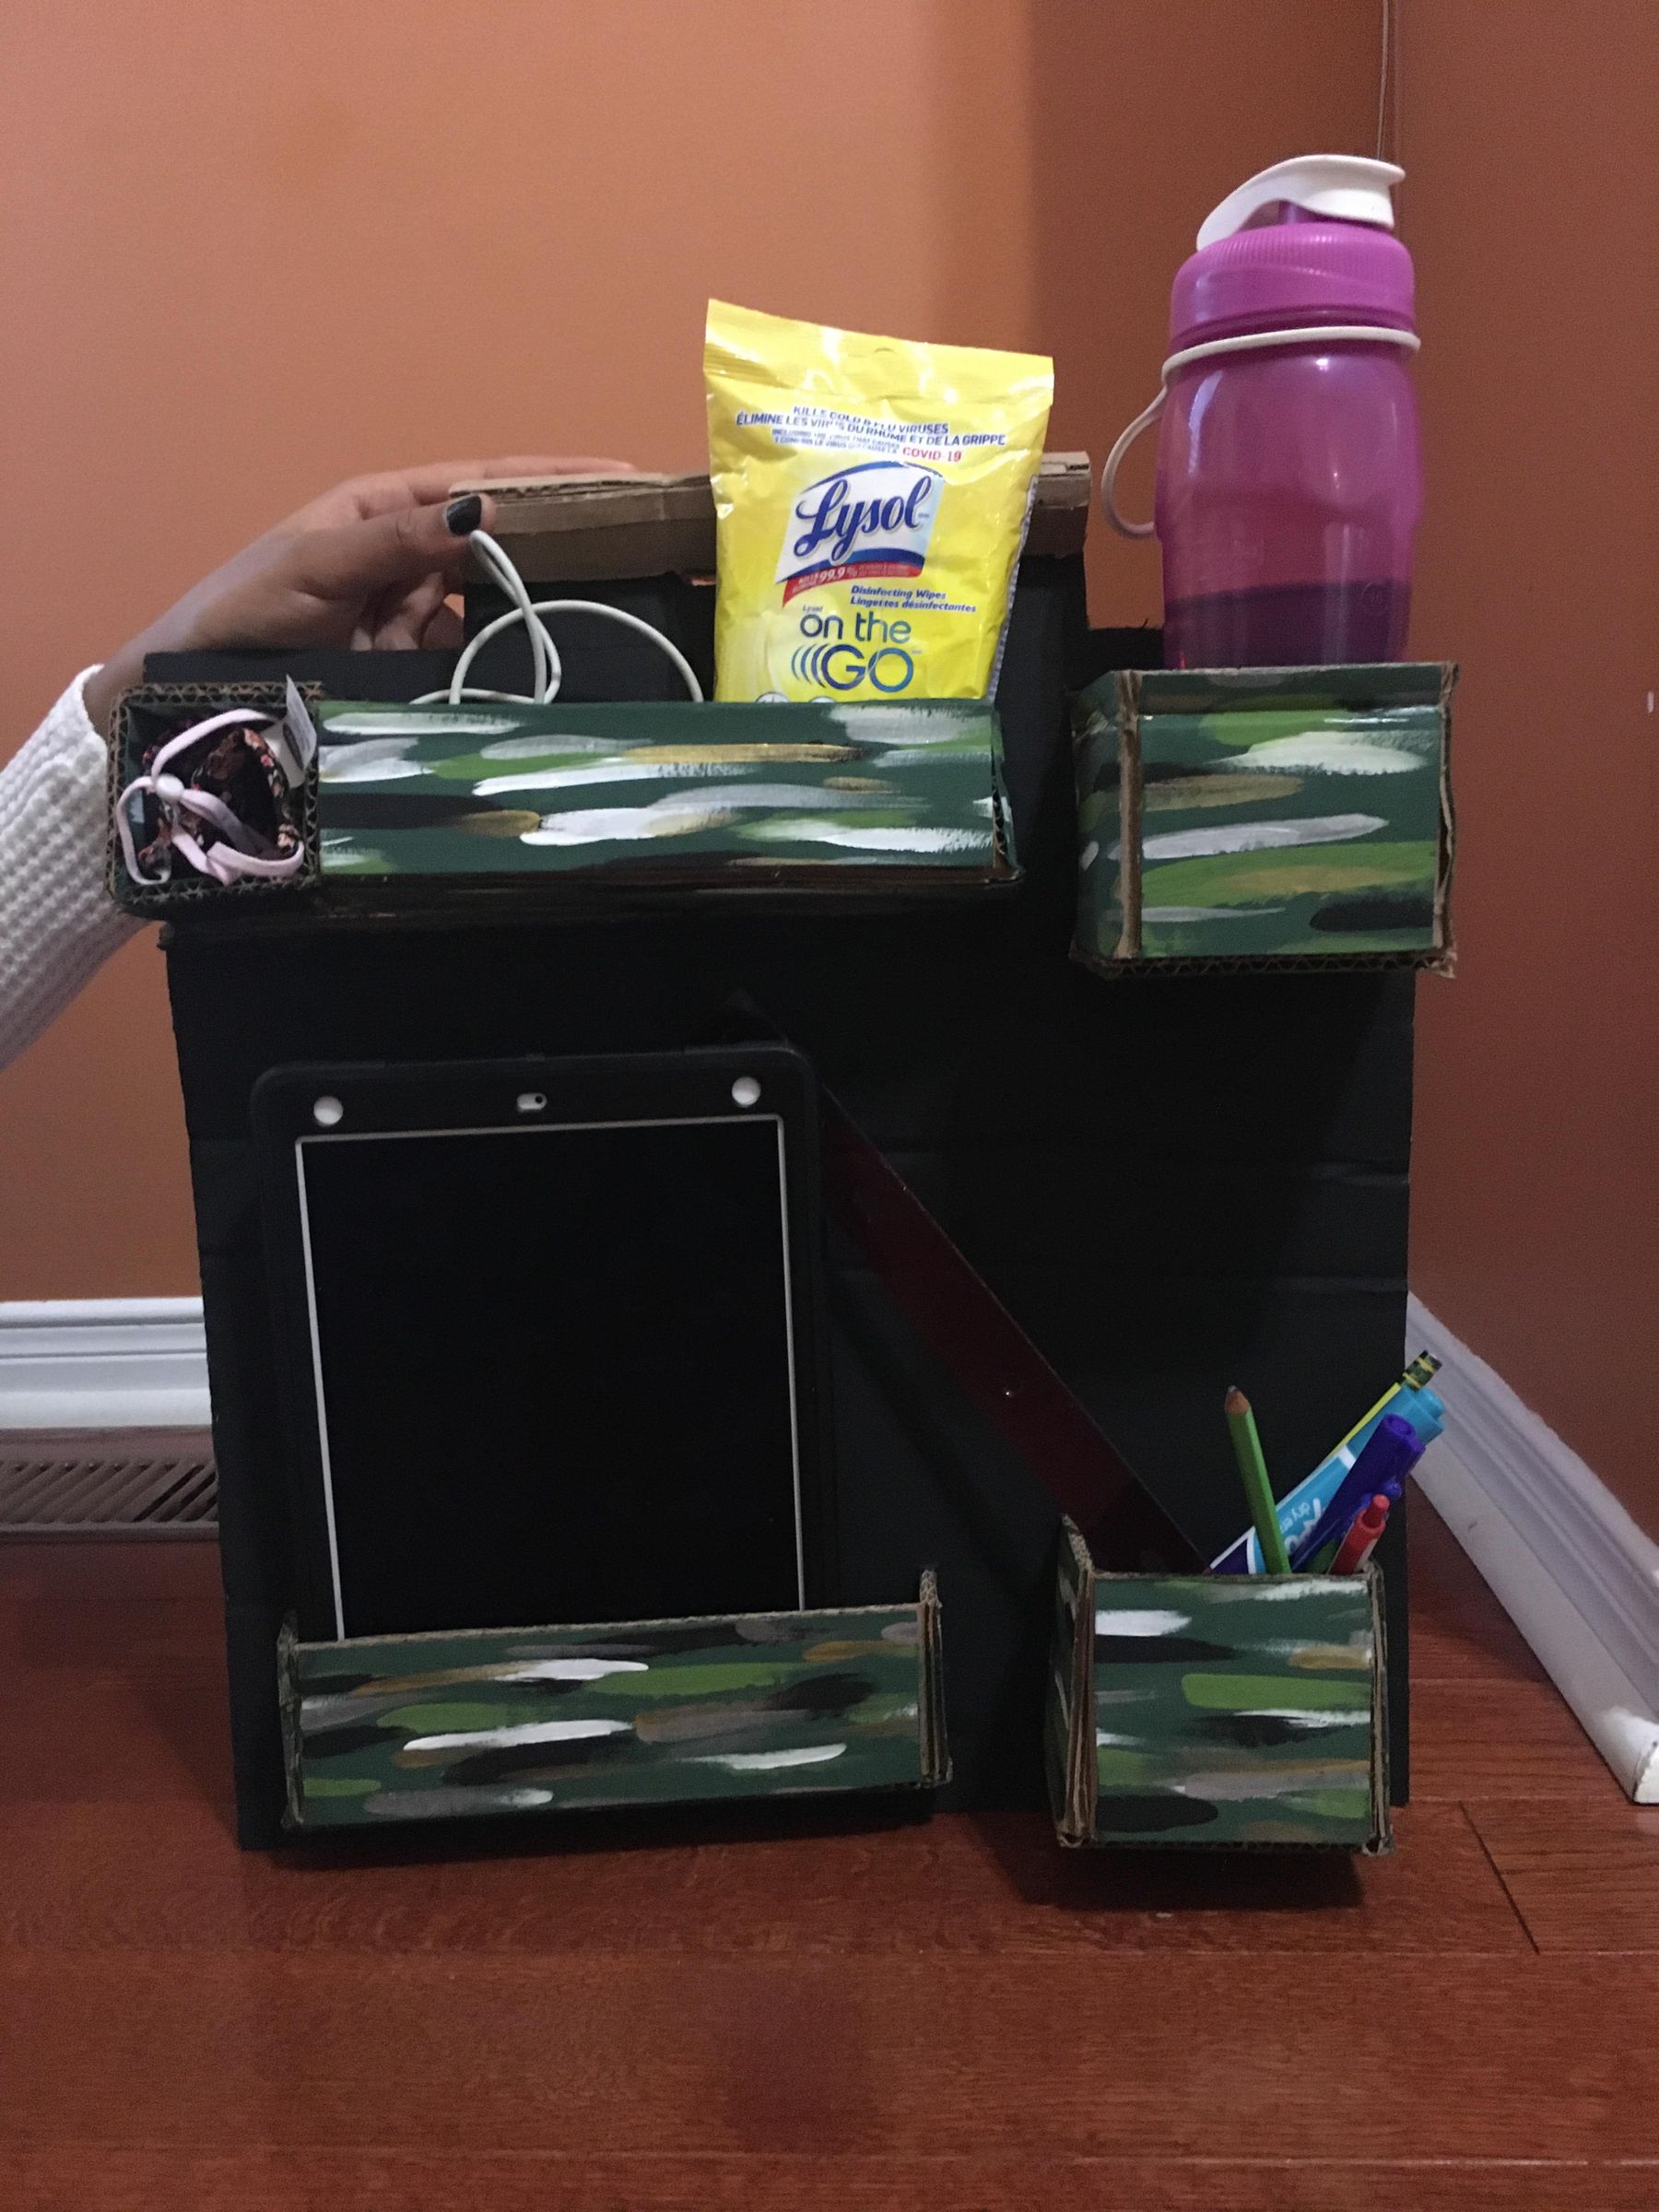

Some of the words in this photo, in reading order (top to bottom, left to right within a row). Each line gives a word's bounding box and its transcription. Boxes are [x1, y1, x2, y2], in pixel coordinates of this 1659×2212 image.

[736, 410, 783, 426] ÉLIMINE
[785, 416, 808, 426] LES
[848, 424, 864, 434] DU
[926, 436, 942, 446] DE
[944, 435, 959, 446] LA
[962, 434, 1006, 446] GRIPPE
[899, 423, 948, 434] VIRUSES
[794, 476, 932, 561] Lysol
[850, 596, 899, 609] Lingettes
[851, 584, 913, 599] Disinfecting
[915, 588, 947, 600] Wipes
[800, 614, 843, 640] on
[855, 611, 912, 643] the
